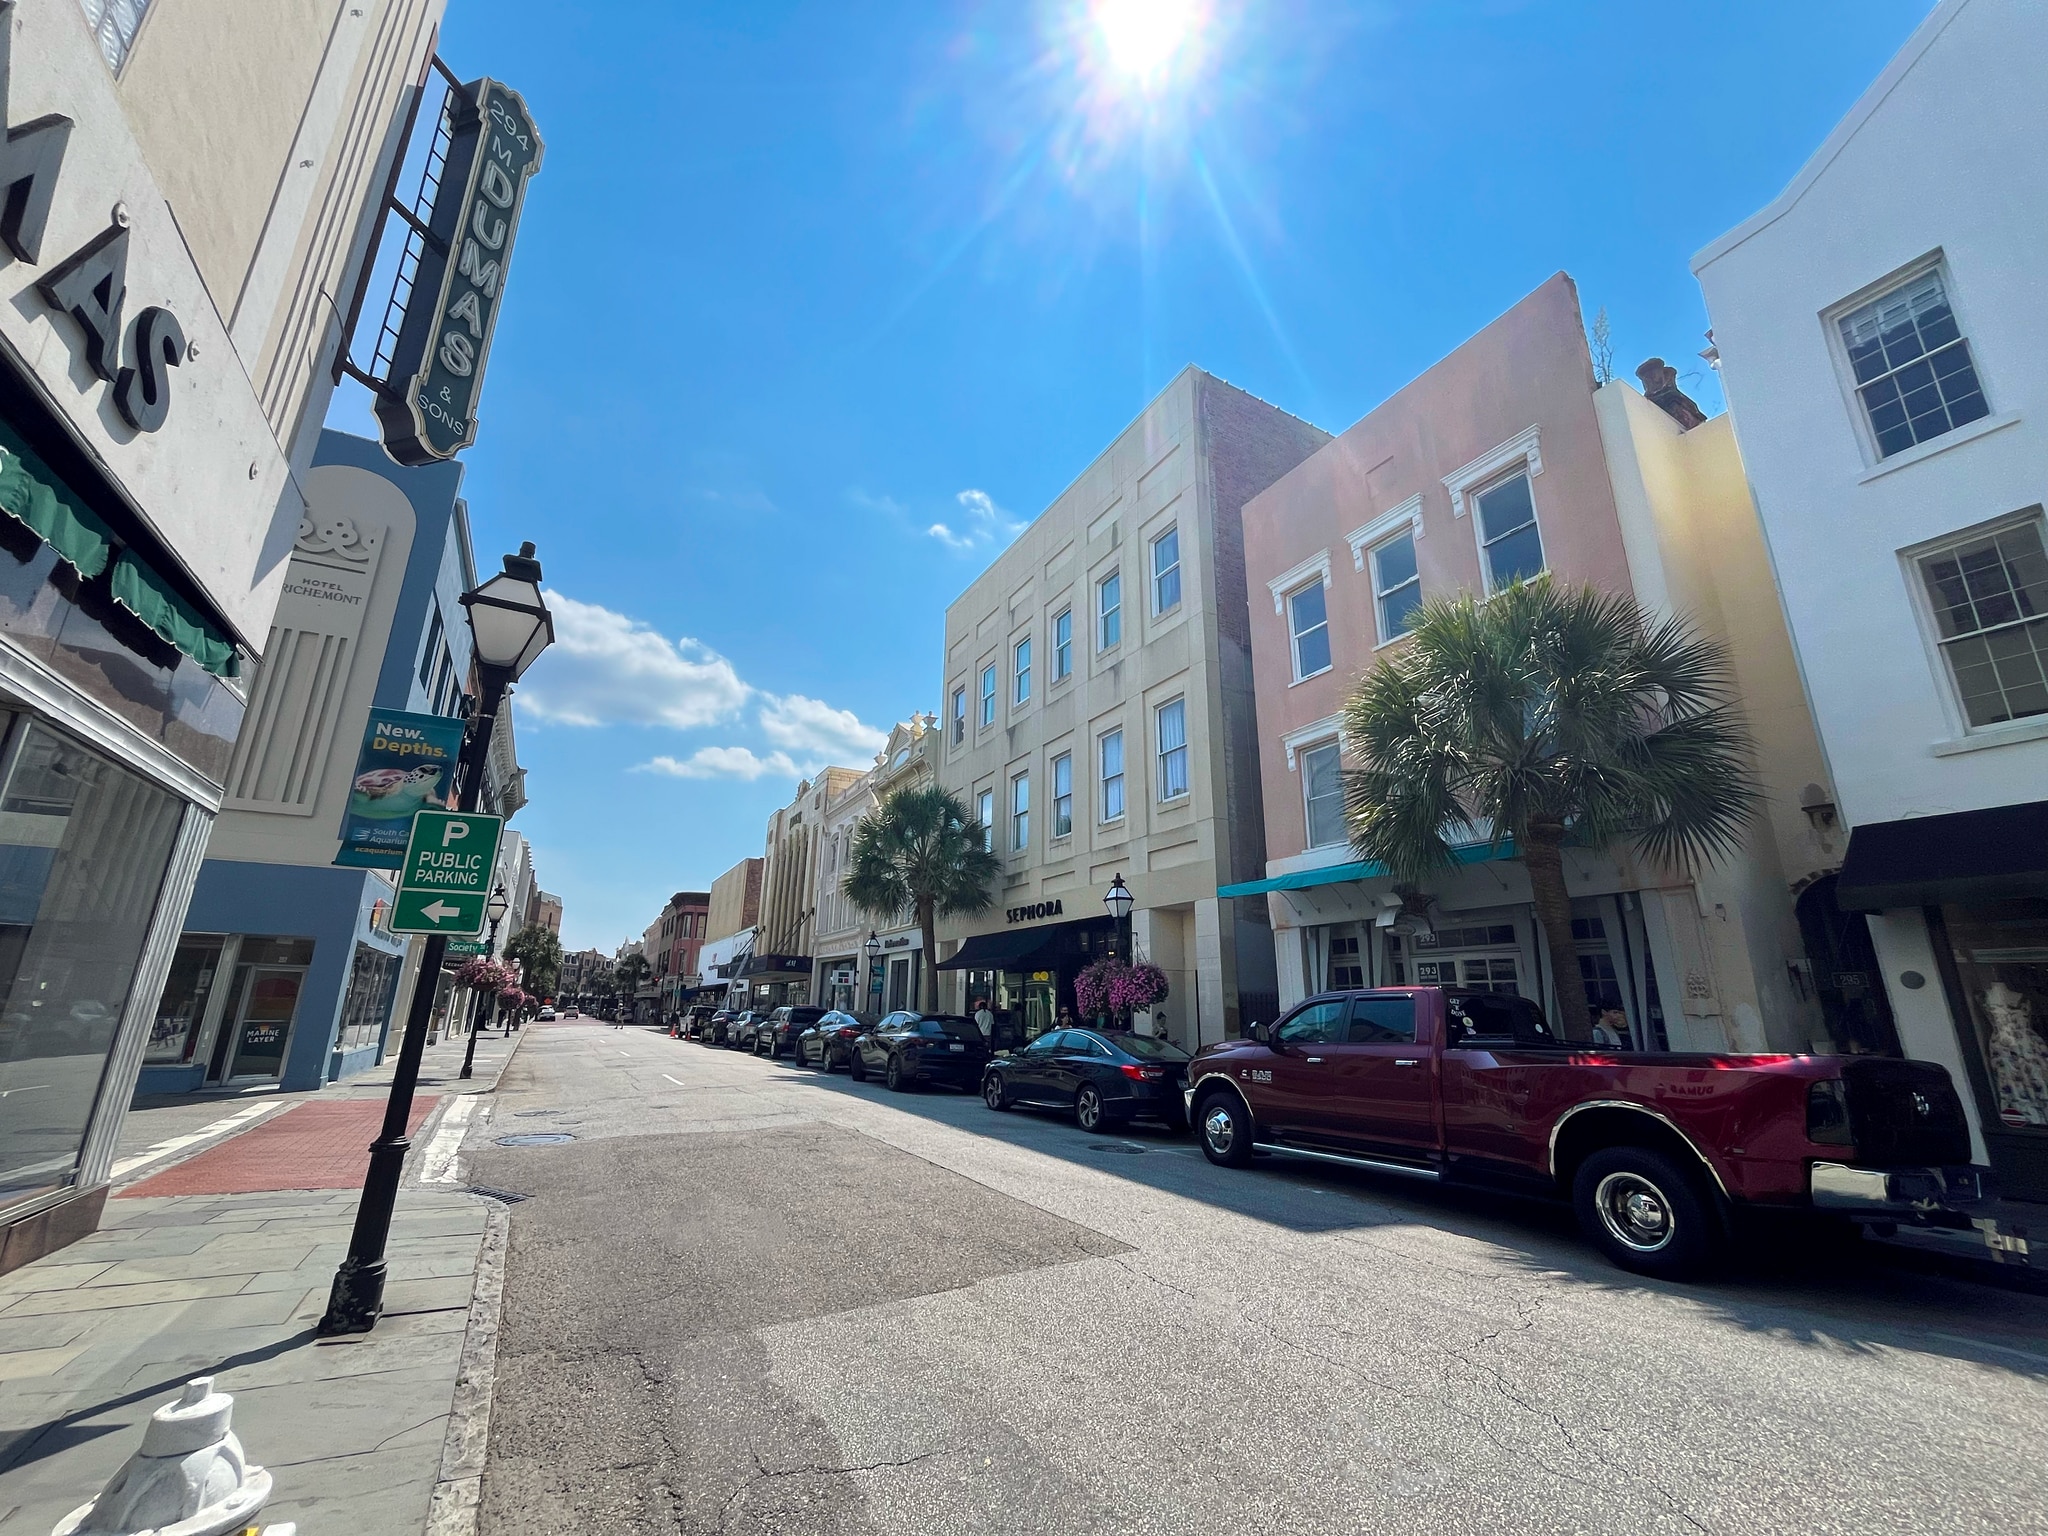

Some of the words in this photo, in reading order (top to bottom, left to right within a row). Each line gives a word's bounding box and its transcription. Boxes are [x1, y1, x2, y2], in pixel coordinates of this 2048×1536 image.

[489, 100, 529, 152] 294
[493, 135, 515, 174] M.
[439, 159, 514, 377] DUMAS
[439, 386, 452, 405] &
[417, 394, 464, 436] SONS
[282, 583, 362, 605] RICHEMONT
[302, 578, 343, 592] HOTEL
[376, 722, 425, 740] New.
[372, 737, 448, 758] Depths.
[372, 828, 397, 837] South
[442, 821, 470, 847] P
[418, 851, 482, 870] PUBLIC
[415, 869, 478, 885] PARKING
[1006, 899, 1063, 924] SEPHORA
[448, 942, 478, 953] Society
[1420, 933, 1436, 943] 293
[1420, 967, 1437, 975] 293
[1839, 975, 1861, 986] 295
[246, 1029, 280, 1038] MARINE
